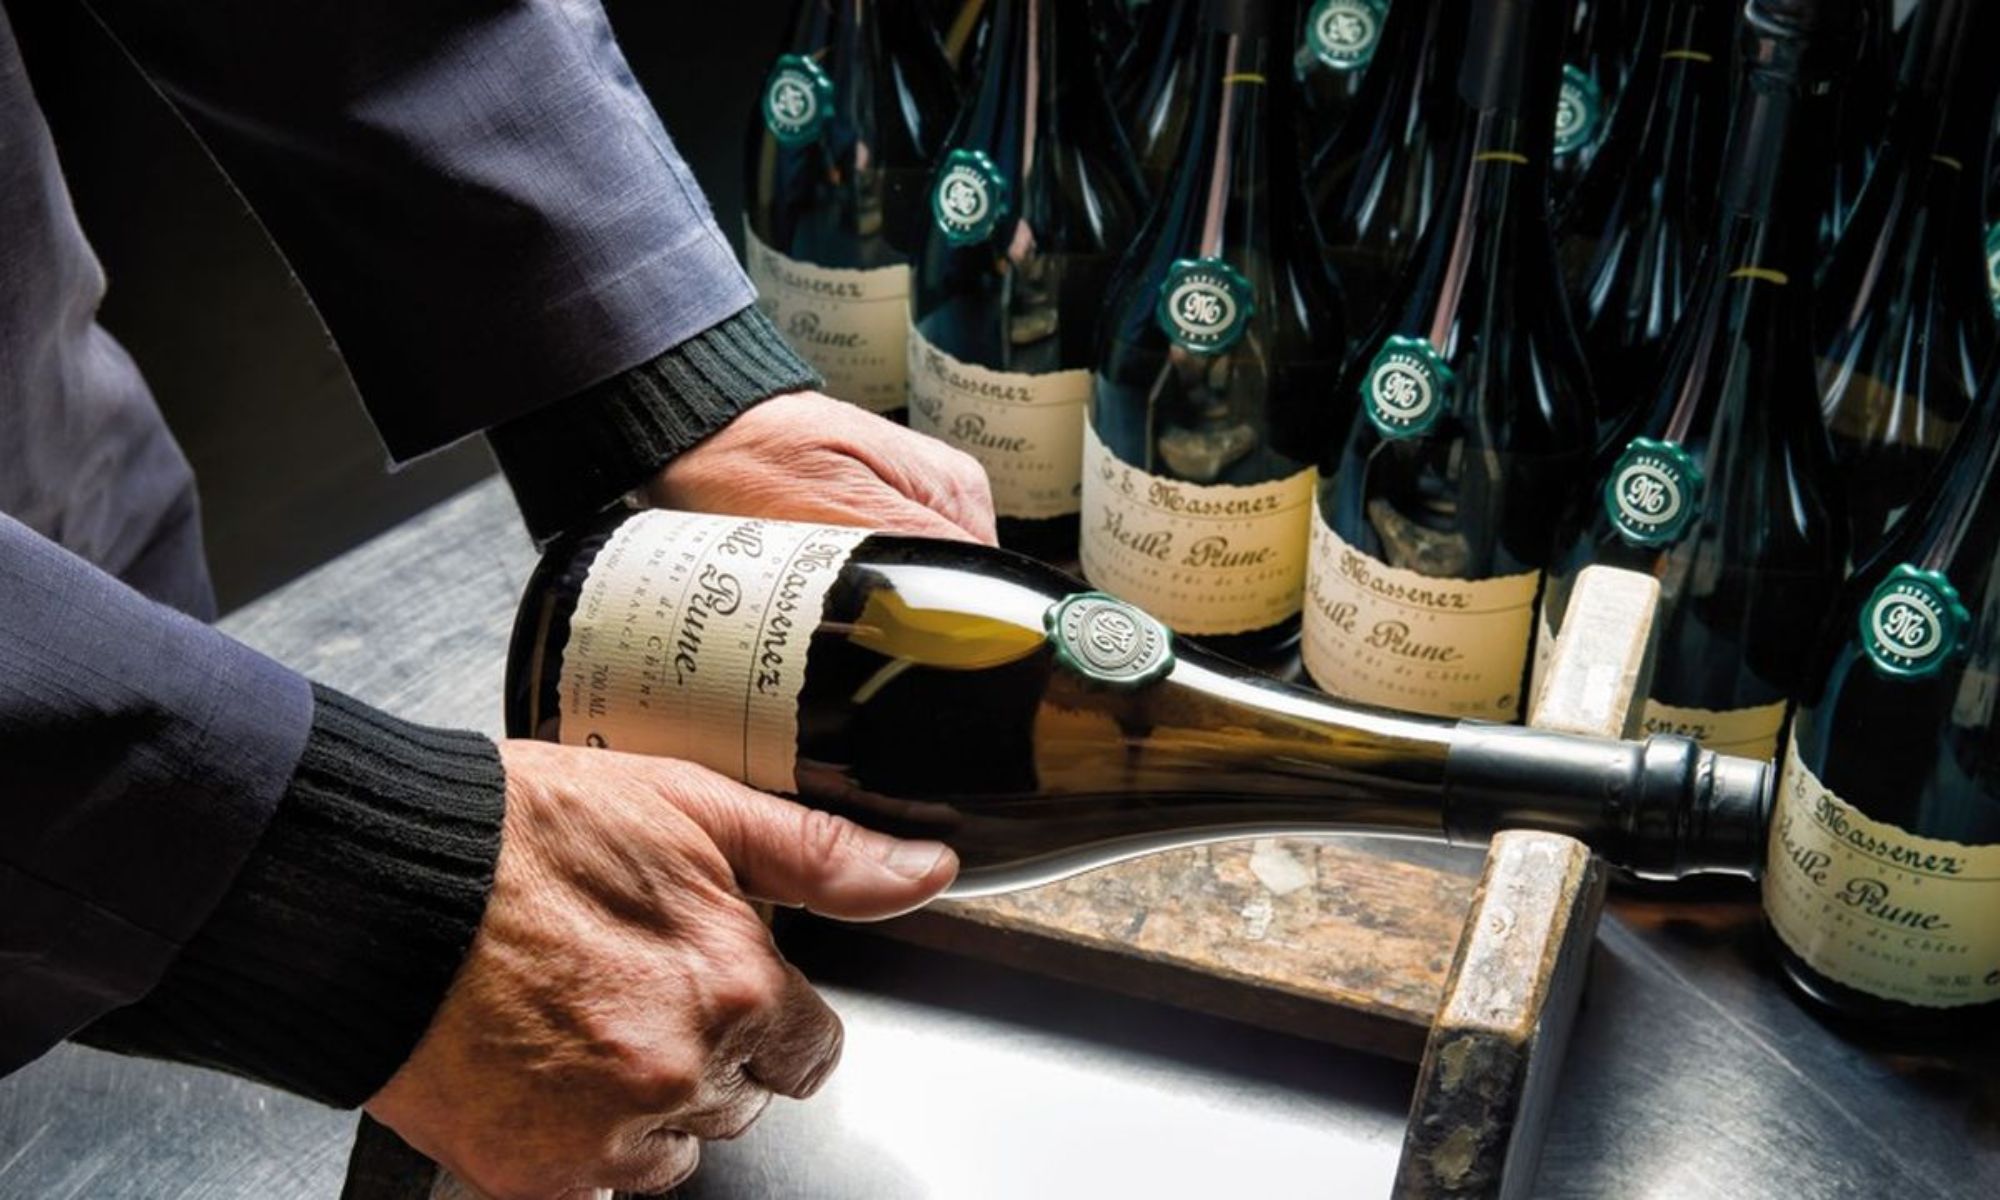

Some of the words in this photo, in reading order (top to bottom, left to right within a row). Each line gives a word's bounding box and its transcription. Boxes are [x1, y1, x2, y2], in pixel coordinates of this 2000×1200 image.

[950, 413, 1037, 452] Prune
[1148, 481, 1281, 516] Massenez
[1181, 534, 1279, 570] Prune
[1341, 550, 1471, 610] Massenez
[674, 562, 743, 687] Prune
[757, 543, 842, 694] Massenez
[1363, 619, 1466, 664] Prune
[1814, 794, 1963, 875] Massenez
[1835, 877, 1952, 930] Prune
